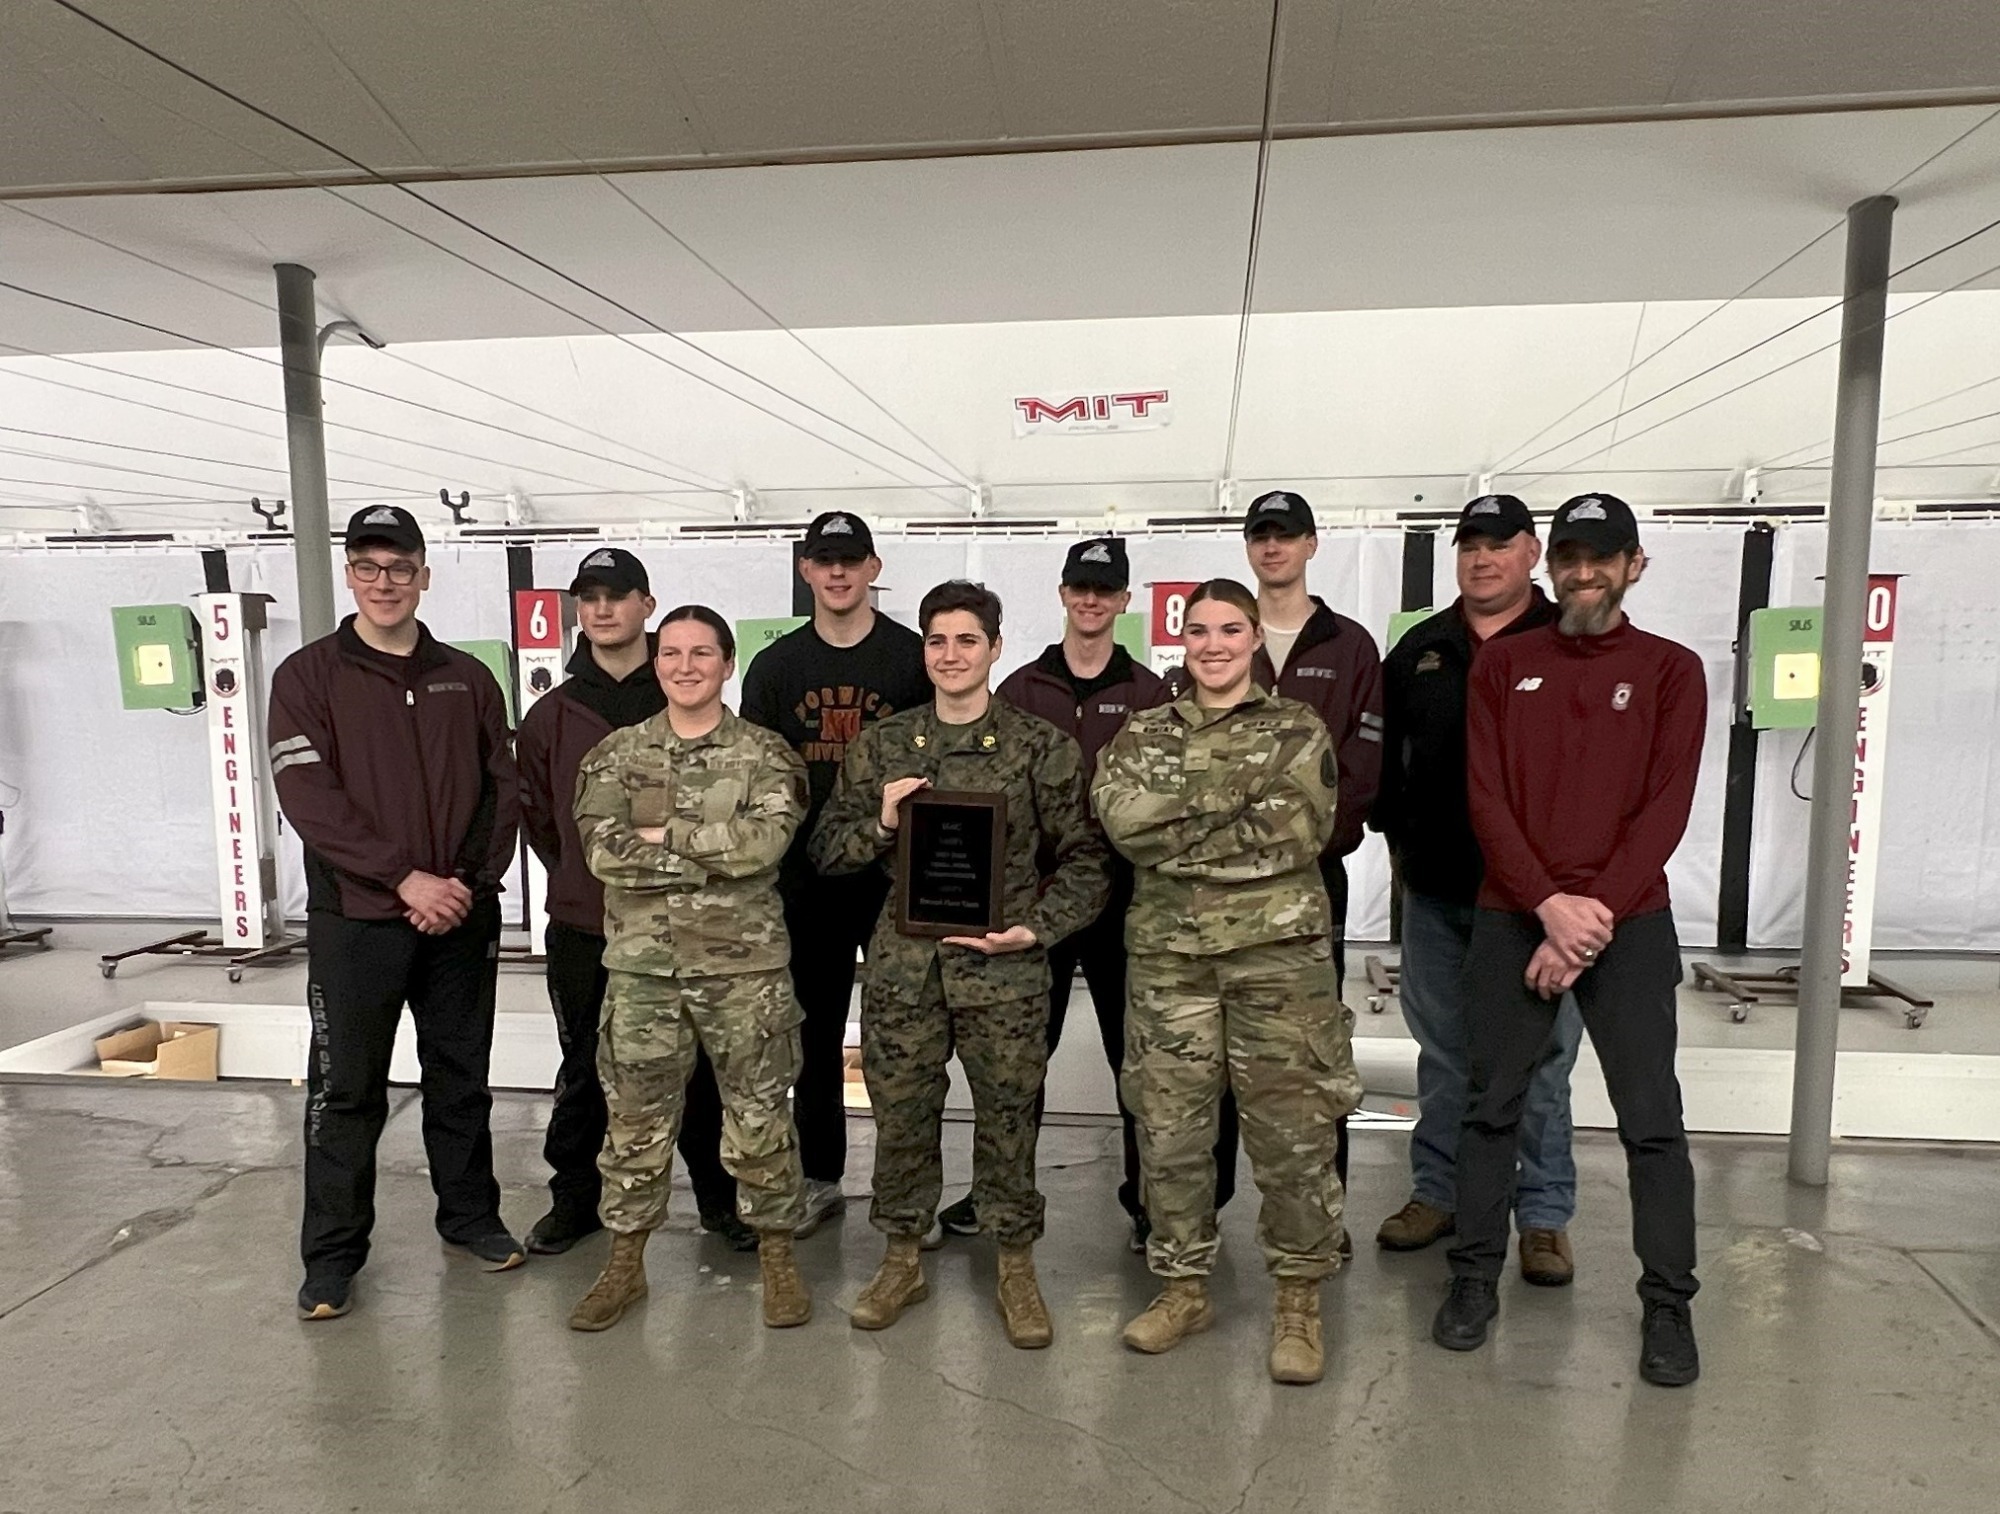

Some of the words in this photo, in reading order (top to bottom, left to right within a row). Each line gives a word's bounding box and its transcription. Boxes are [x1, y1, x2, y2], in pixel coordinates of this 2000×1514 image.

[1015, 390, 1168, 423] MIT
[213, 605, 229, 641] 5
[530, 600, 548, 640] 6
[1165, 594, 1186, 636] 8
[222, 706, 249, 939] ENGINEERS
